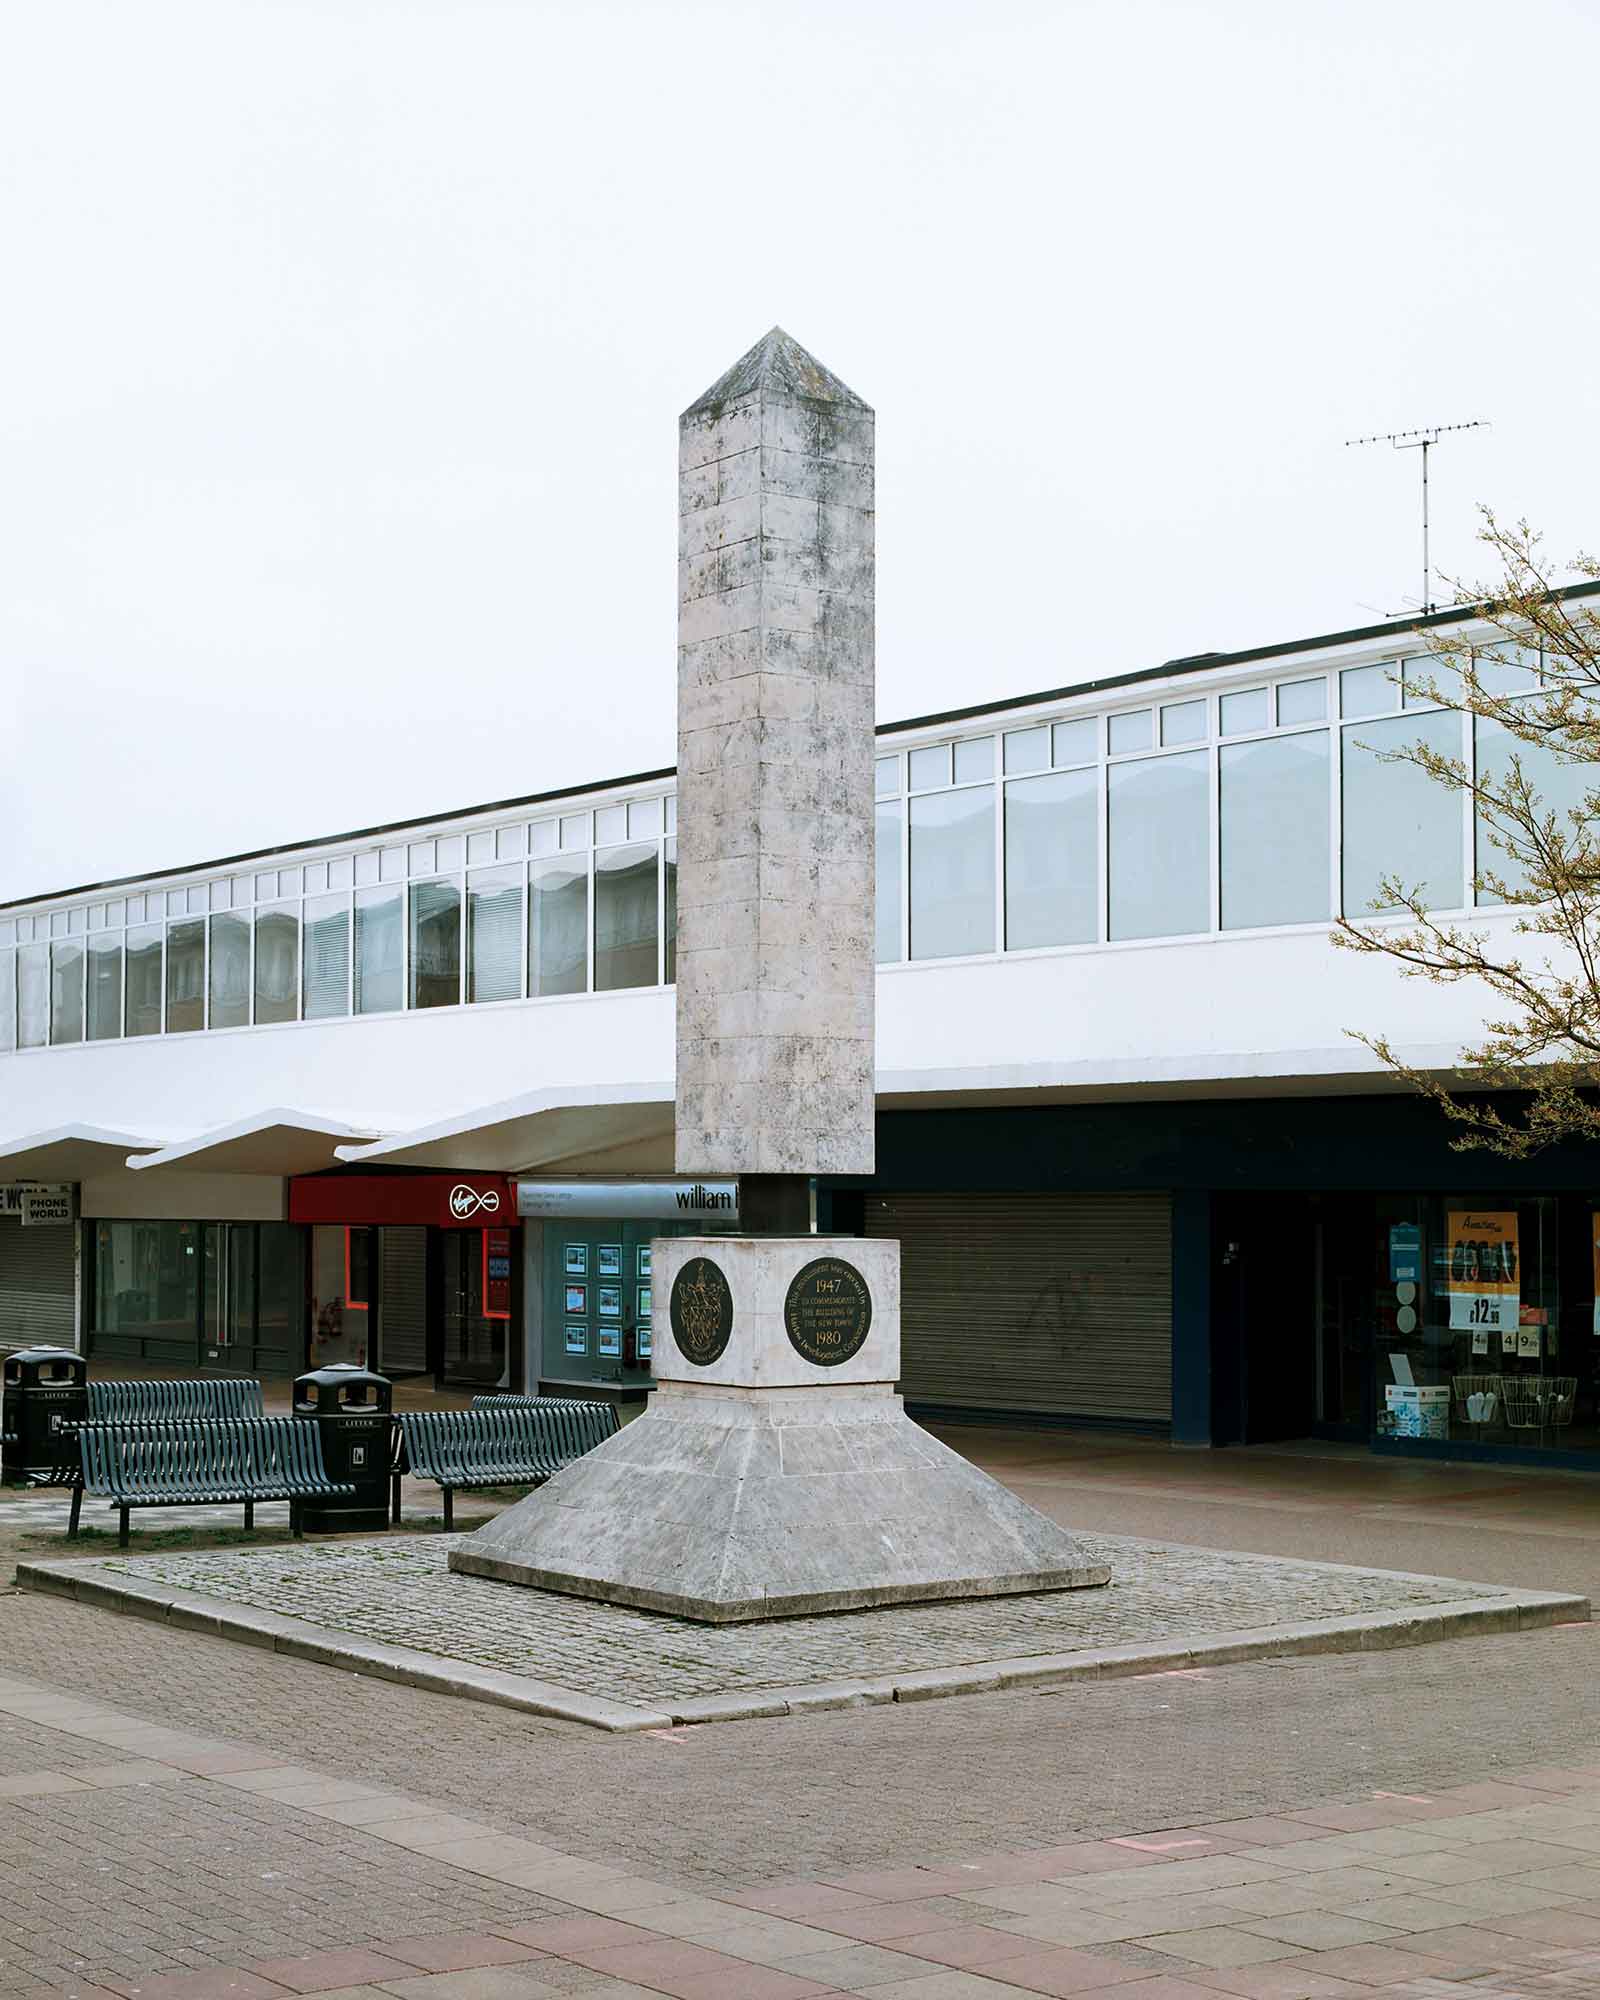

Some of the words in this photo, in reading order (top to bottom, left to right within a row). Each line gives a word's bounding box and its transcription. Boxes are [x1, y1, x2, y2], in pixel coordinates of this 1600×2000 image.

[30, 1199, 67, 1208] PHONE
[675, 1184, 731, 1209] william
[30, 1209, 68, 1218] WORLD
[815, 1279, 841, 1293] 1947
[816, 1331, 841, 1345] 1980
